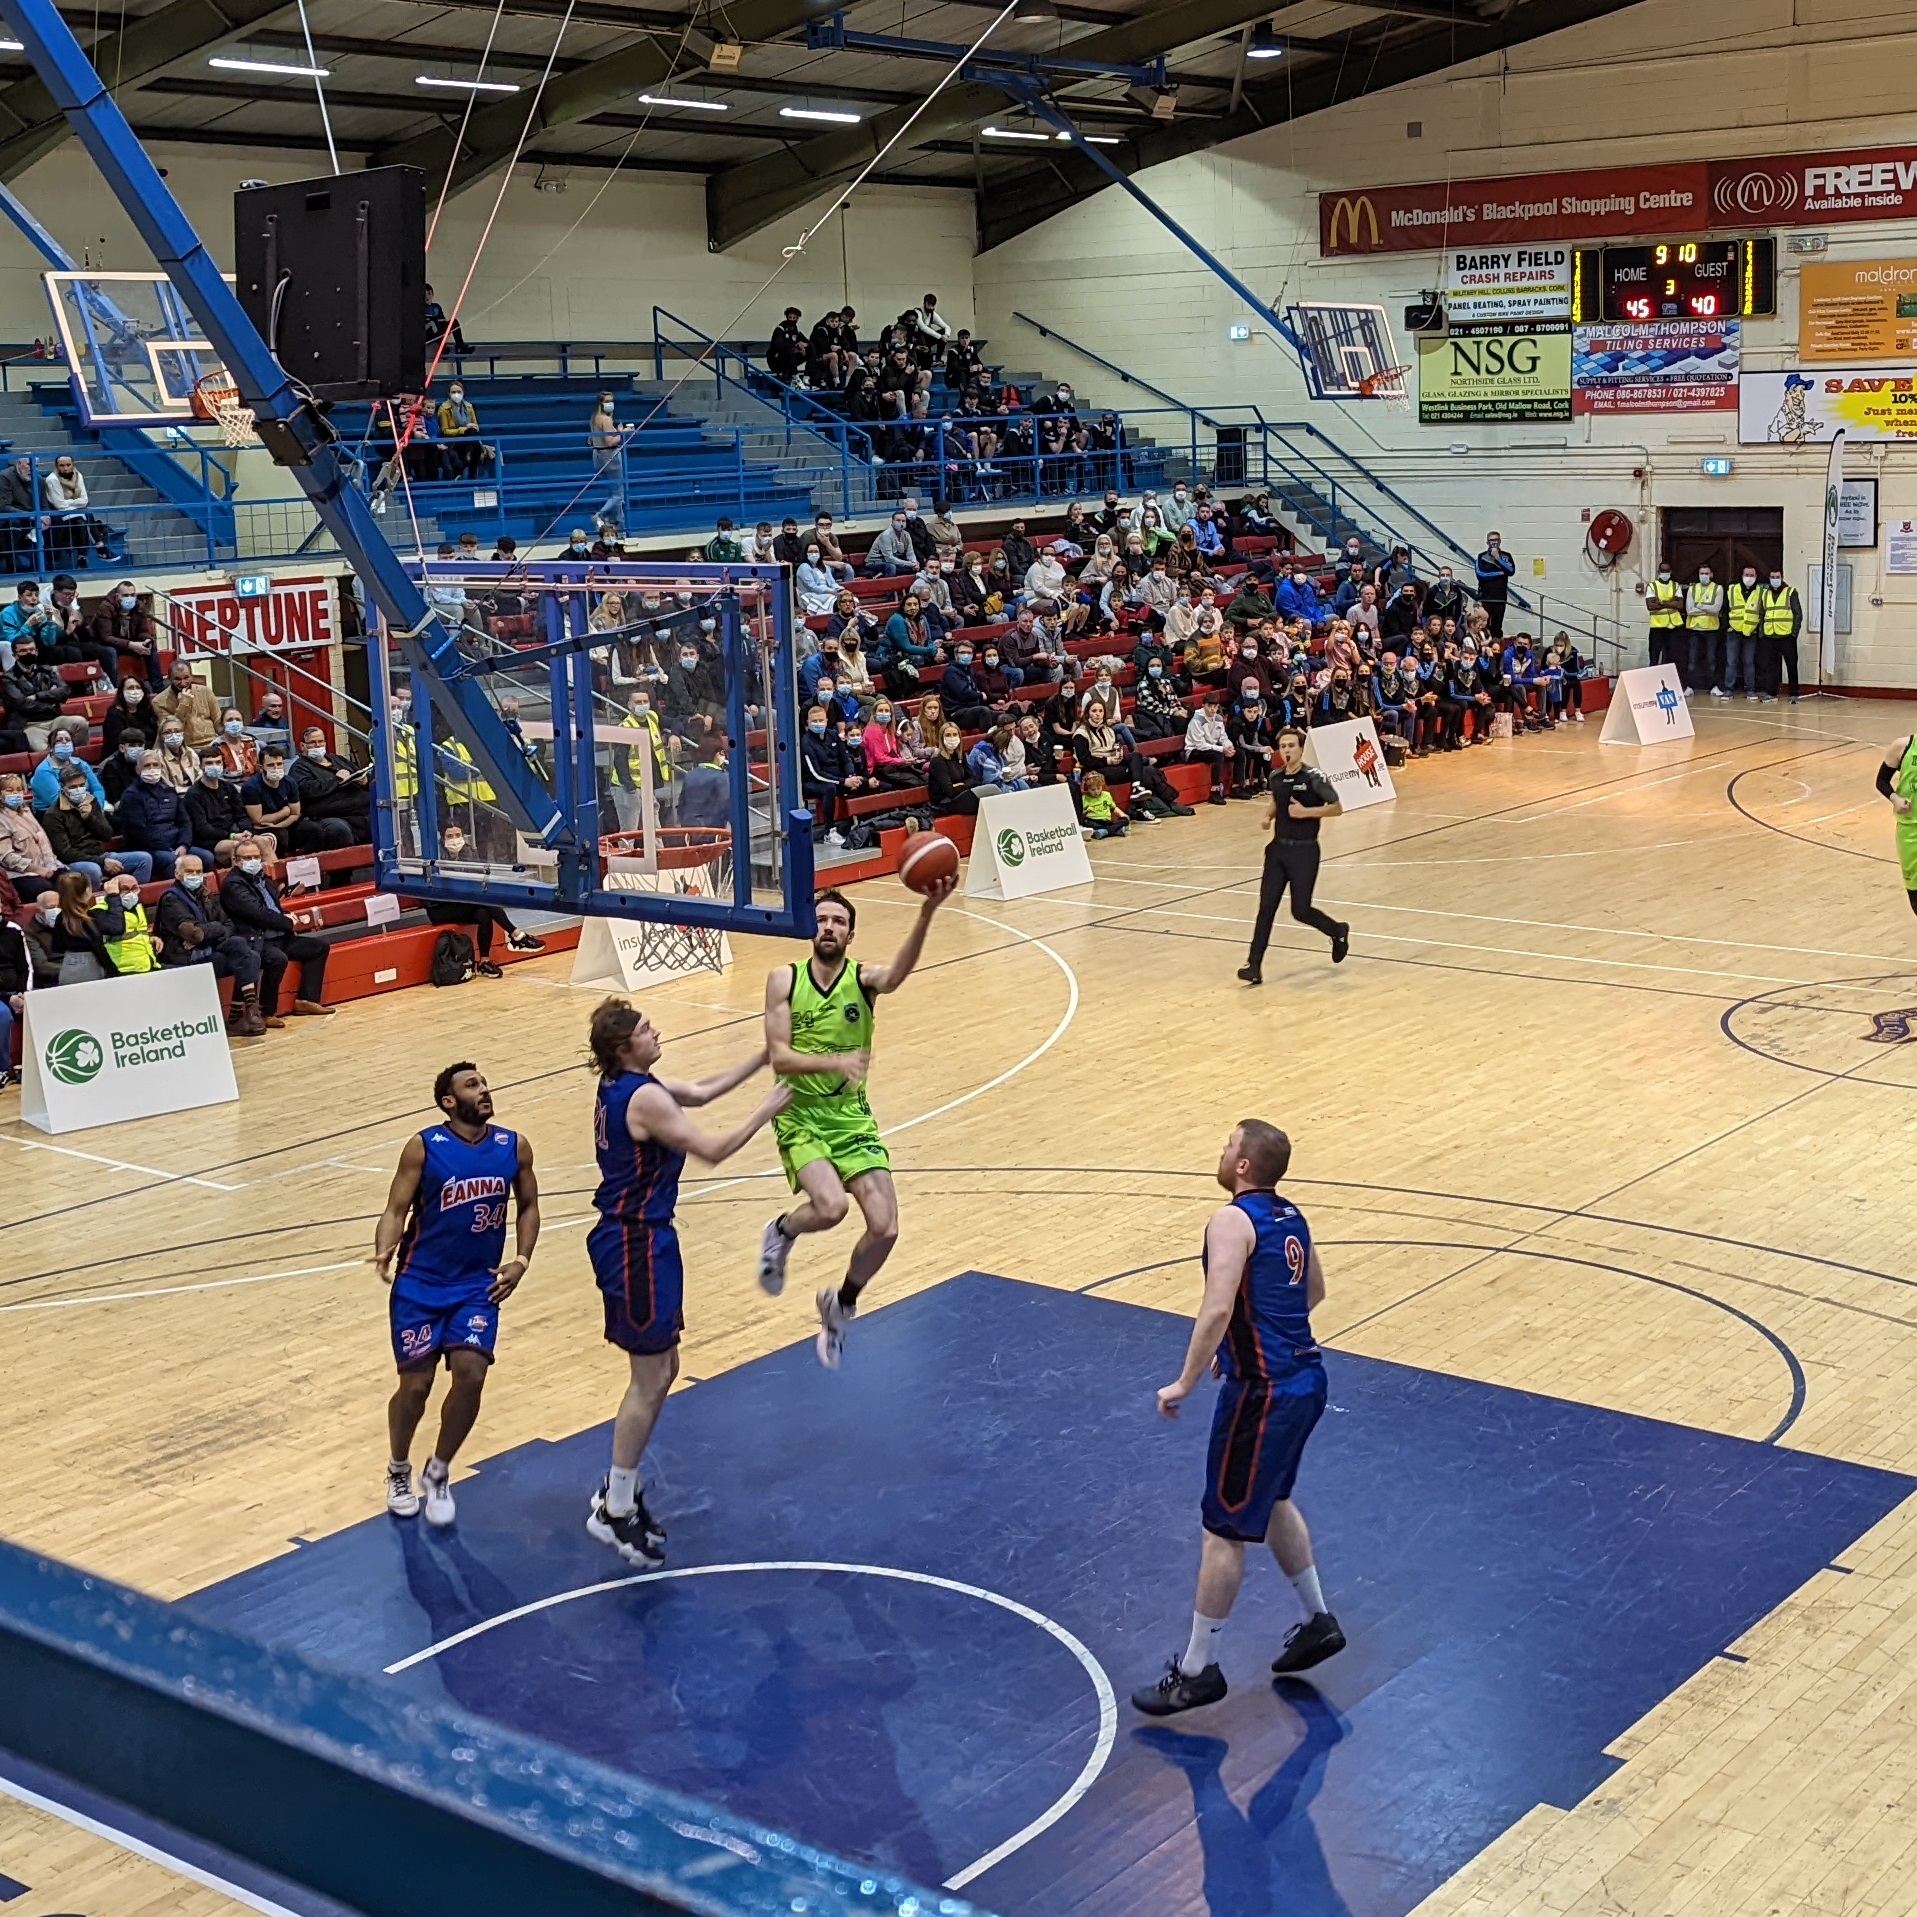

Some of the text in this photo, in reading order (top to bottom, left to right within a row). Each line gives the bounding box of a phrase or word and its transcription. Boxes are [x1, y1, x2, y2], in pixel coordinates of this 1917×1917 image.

[1391, 189, 1693, 228] McDonald's Blackpool Shopping Centre
[1804, 193, 1903, 211] Available inside
[1456, 250, 1565, 272] BARRY FIELD
[1461, 269, 1555, 285] CRASH REPAIRS
[1614, 262, 1728, 283] HOME GUEST
[1665, 279, 1675, 295] 3
[1448, 301, 1470, 311] PANEL
[1508, 298, 1532, 308] SPRAY
[1534, 297, 1569, 306] PAINTING
[1626, 298, 1650, 318] 45
[1692, 295, 1716, 315] 40
[1585, 320, 1726, 339] MALCOLM THOMPSON
[1605, 337, 1706, 351] TILING SERVICES
[1450, 337, 1541, 376] NSG
[1450, 378, 1495, 386] NORTHSIDE
[1523, 376, 1540, 384] LTD.
[1579, 377, 1601, 385] SUPPLY
[1608, 376, 1634, 384] FITTING
[1634, 375, 1664, 383] SERVICES
[1670, 374, 1686, 382] FREE
[1687, 373, 1728, 382] QUOTATION
[1824, 377, 1914, 393] SAVE
[1490, 389, 1520, 397] MIRROR
[1521, 388, 1569, 396] SPECIALISTS
[1585, 389, 1616, 400] PHONE
[1421, 403, 1449, 412] Westlink
[1450, 402, 1477, 411] Business
[1508, 401, 1532, 410] Mallow
[1553, 400, 1570, 409] Cork
[1863, 407, 1893, 416] Just
[169, 589, 331, 654] NEPTUNE
[1357, 744, 1376, 768] HOUSE
[1025, 822, 1078, 845] Basketball
[1029, 839, 1064, 857] Ireland
[110, 1015, 219, 1050] Basketball
[114, 1040, 186, 1068] Ireland
[471, 1203, 506, 1233] 34
[1284, 1235, 1305, 1286] 9
[401, 1323, 432, 1356] 34
